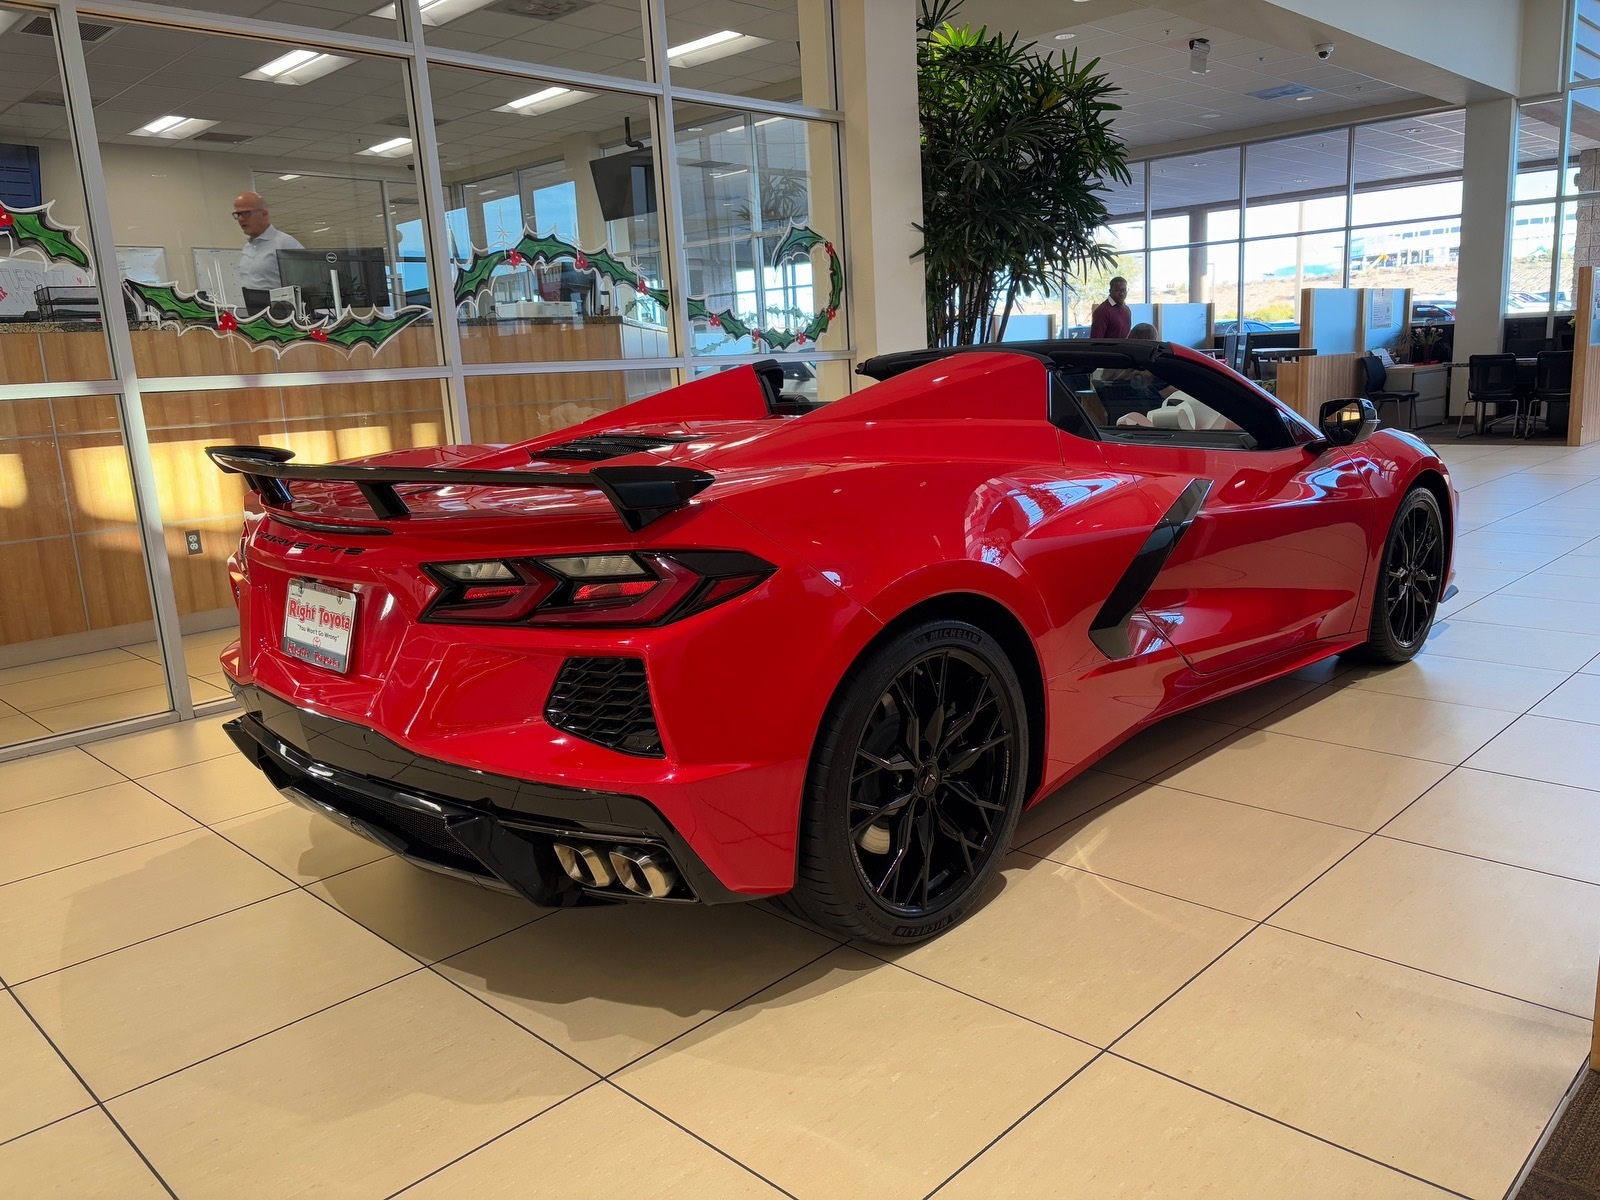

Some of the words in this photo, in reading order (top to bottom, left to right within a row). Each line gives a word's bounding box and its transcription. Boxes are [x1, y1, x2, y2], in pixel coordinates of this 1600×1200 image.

[258, 531, 366, 555] CORVETTE
[288, 599, 316, 623] Right
[318, 605, 351, 631] Toyota
[307, 627, 318, 635] Won't
[930, 628, 979, 643] MICHELIN
[287, 642, 309, 658] Right
[313, 650, 340, 668] Toyota
[896, 919, 948, 936] MICHELIN
